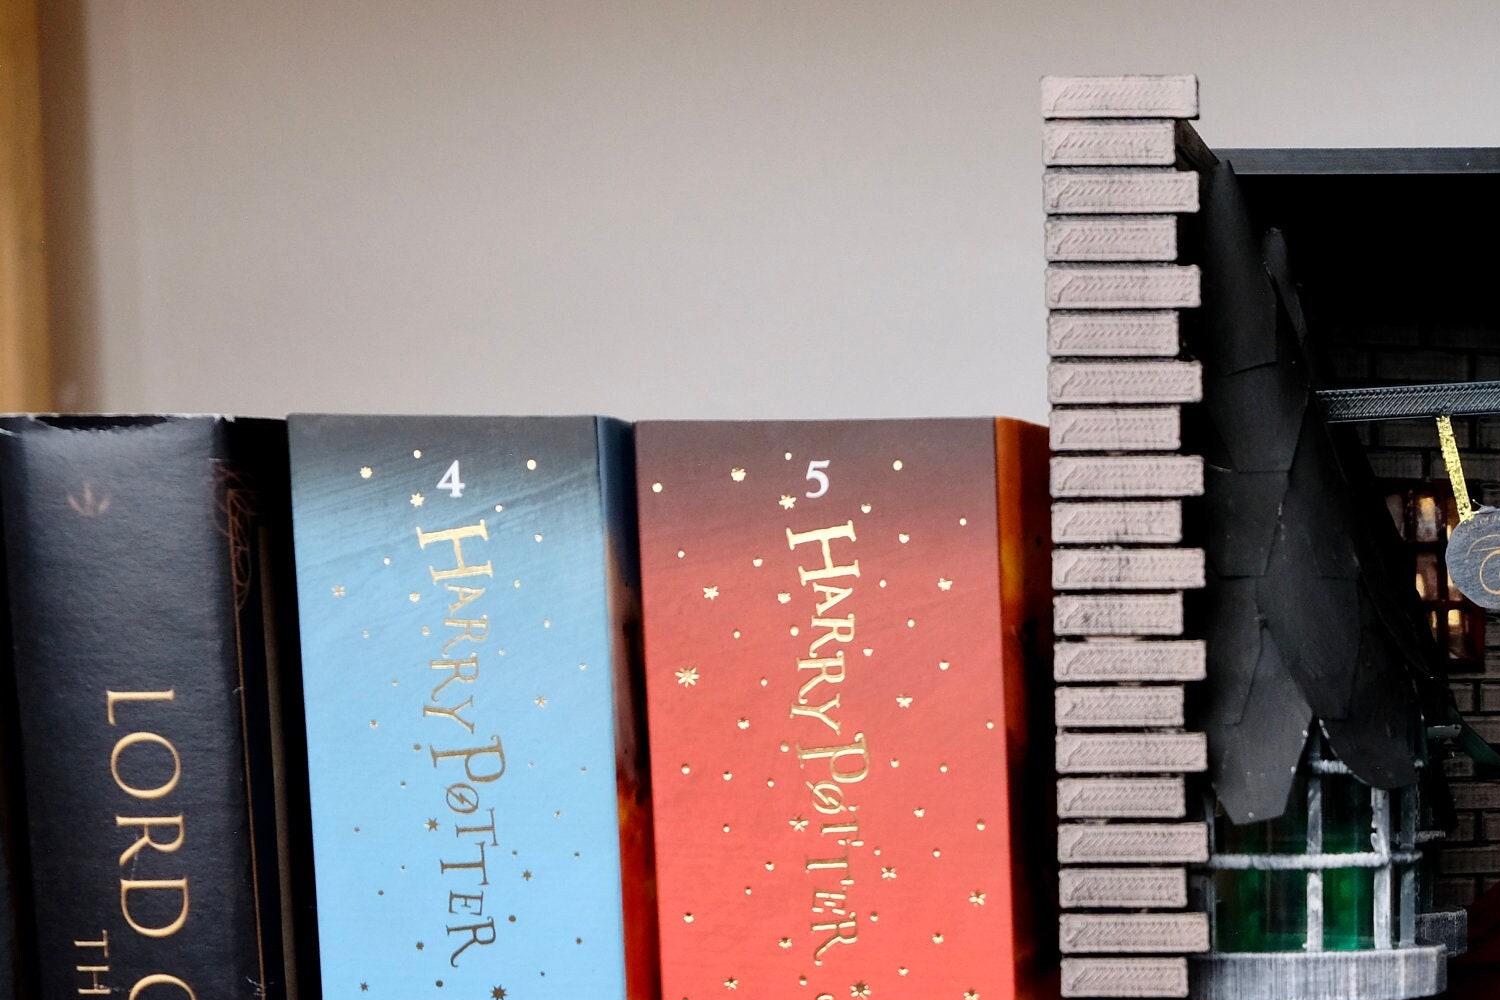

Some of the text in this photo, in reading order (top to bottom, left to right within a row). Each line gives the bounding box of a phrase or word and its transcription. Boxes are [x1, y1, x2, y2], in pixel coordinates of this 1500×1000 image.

[435, 459, 466, 498] 4
[805, 459, 830, 499] 5
[416, 519, 493, 734] HARRY
[786, 520, 860, 735] HARRY
[106, 690, 189, 938] LORD
